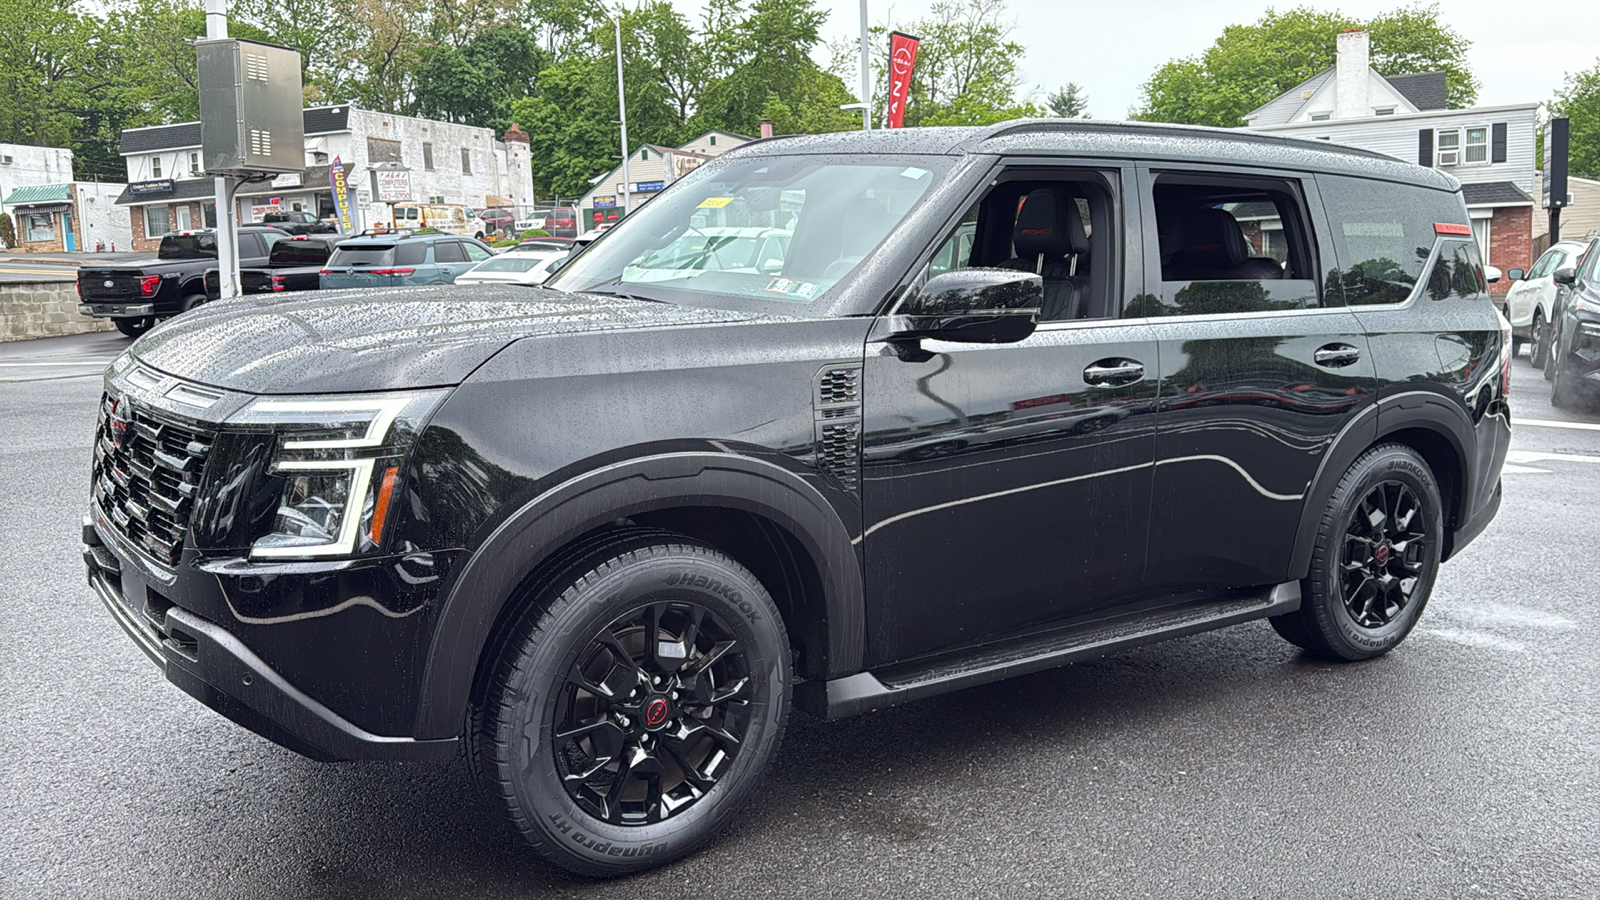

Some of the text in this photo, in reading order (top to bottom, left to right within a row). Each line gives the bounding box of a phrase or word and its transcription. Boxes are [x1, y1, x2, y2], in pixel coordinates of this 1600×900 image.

[379, 179, 408, 187] COMPUTERS
[334, 172, 352, 230] COMPUTER
[379, 191, 411, 201] 942-9700
[547, 813, 574, 835] HT
